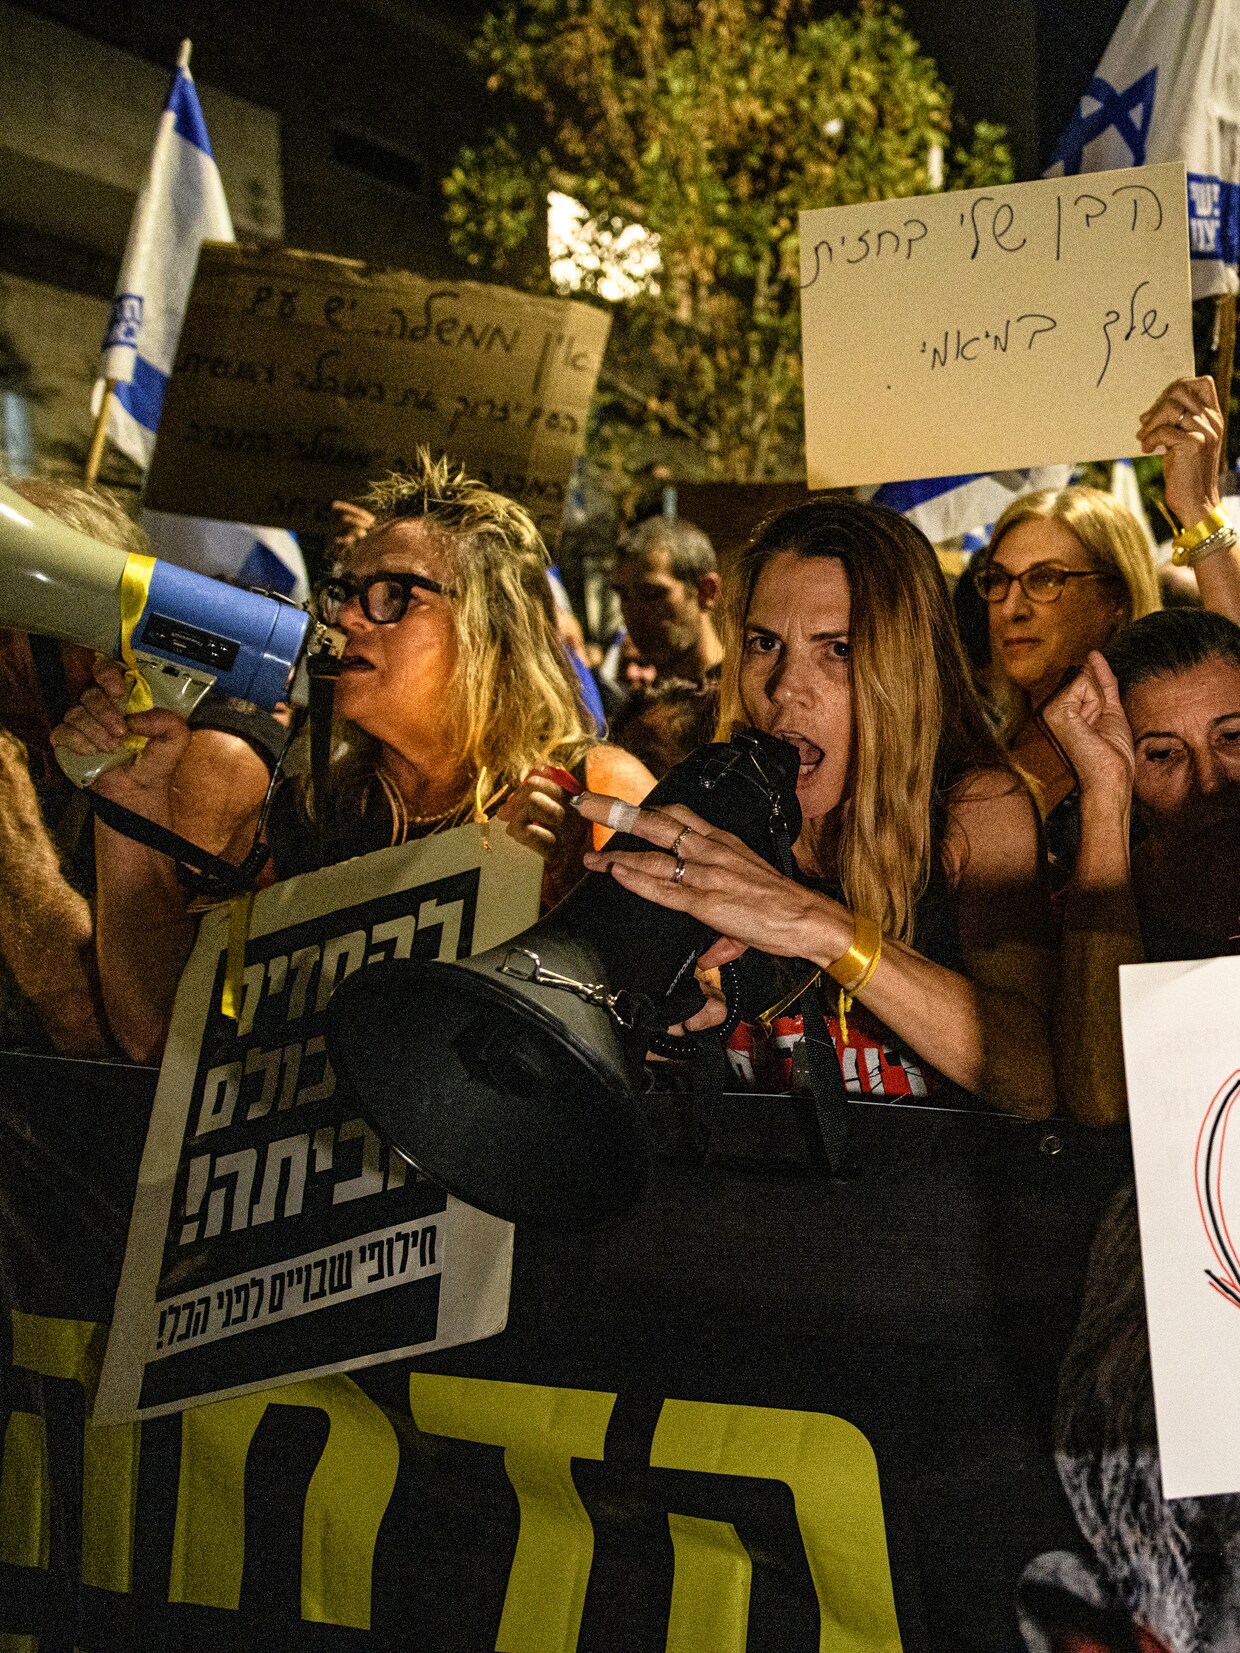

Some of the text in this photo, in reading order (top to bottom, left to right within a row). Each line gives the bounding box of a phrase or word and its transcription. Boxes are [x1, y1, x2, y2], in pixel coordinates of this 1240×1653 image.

[800, 218, 928, 289] בחזית
[959, 196, 1027, 260] שלי
[1055, 185, 1164, 261] הבן
[1096, 280, 1169, 388] שלך
[156, 1224, 438, 1350] חילופי שבויים לפני הכל!
